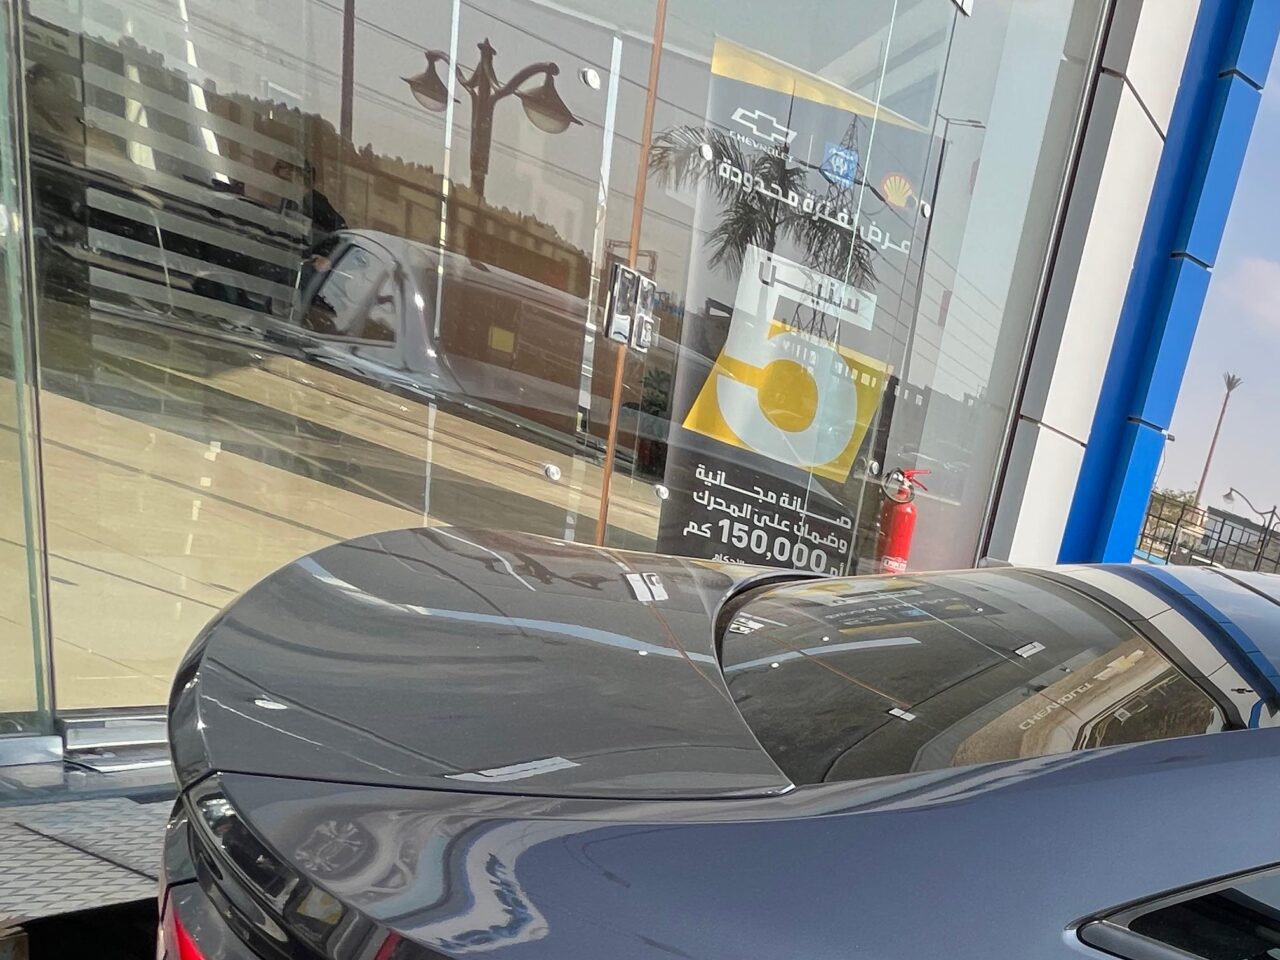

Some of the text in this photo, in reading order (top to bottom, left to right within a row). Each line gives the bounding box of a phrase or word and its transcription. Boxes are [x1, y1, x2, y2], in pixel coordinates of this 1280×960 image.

[729, 130, 794, 163] CHEVROLET
[718, 158, 799, 208] محدودة
[802, 193, 859, 231] لفترة
[860, 221, 911, 254] عرض
[695, 464, 852, 530] صيانة مجانية
[682, 520, 713, 538] كم
[692, 490, 848, 554] وضمان على المحرك
[718, 518, 828, 573] 150,000
